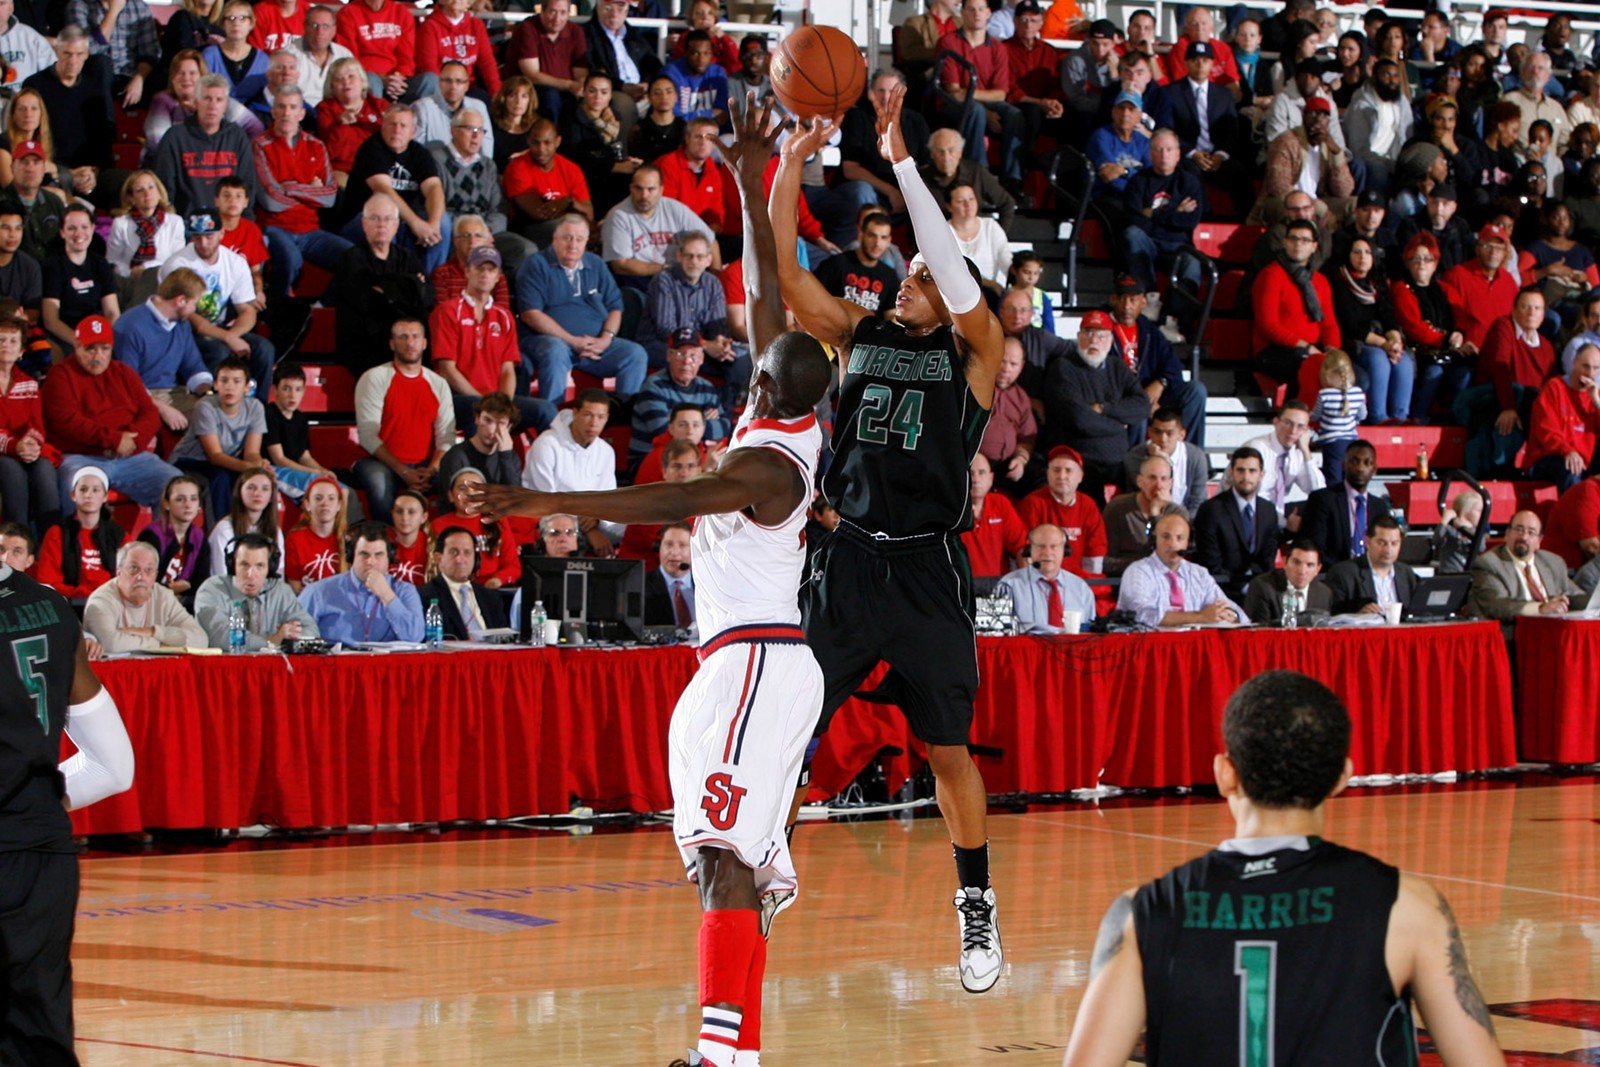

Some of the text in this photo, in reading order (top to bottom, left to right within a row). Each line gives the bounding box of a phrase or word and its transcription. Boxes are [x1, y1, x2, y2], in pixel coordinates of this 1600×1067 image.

[847, 343, 953, 381] WAGNER
[856, 383, 925, 451] 24
[567, 561, 595, 570] DELL
[0, 599, 60, 633] LAHAN
[11, 634, 49, 736] 5
[1244, 857, 1277, 873] NEC
[1183, 886, 1334, 930] HARRIS
[1233, 940, 1278, 1067] 1
